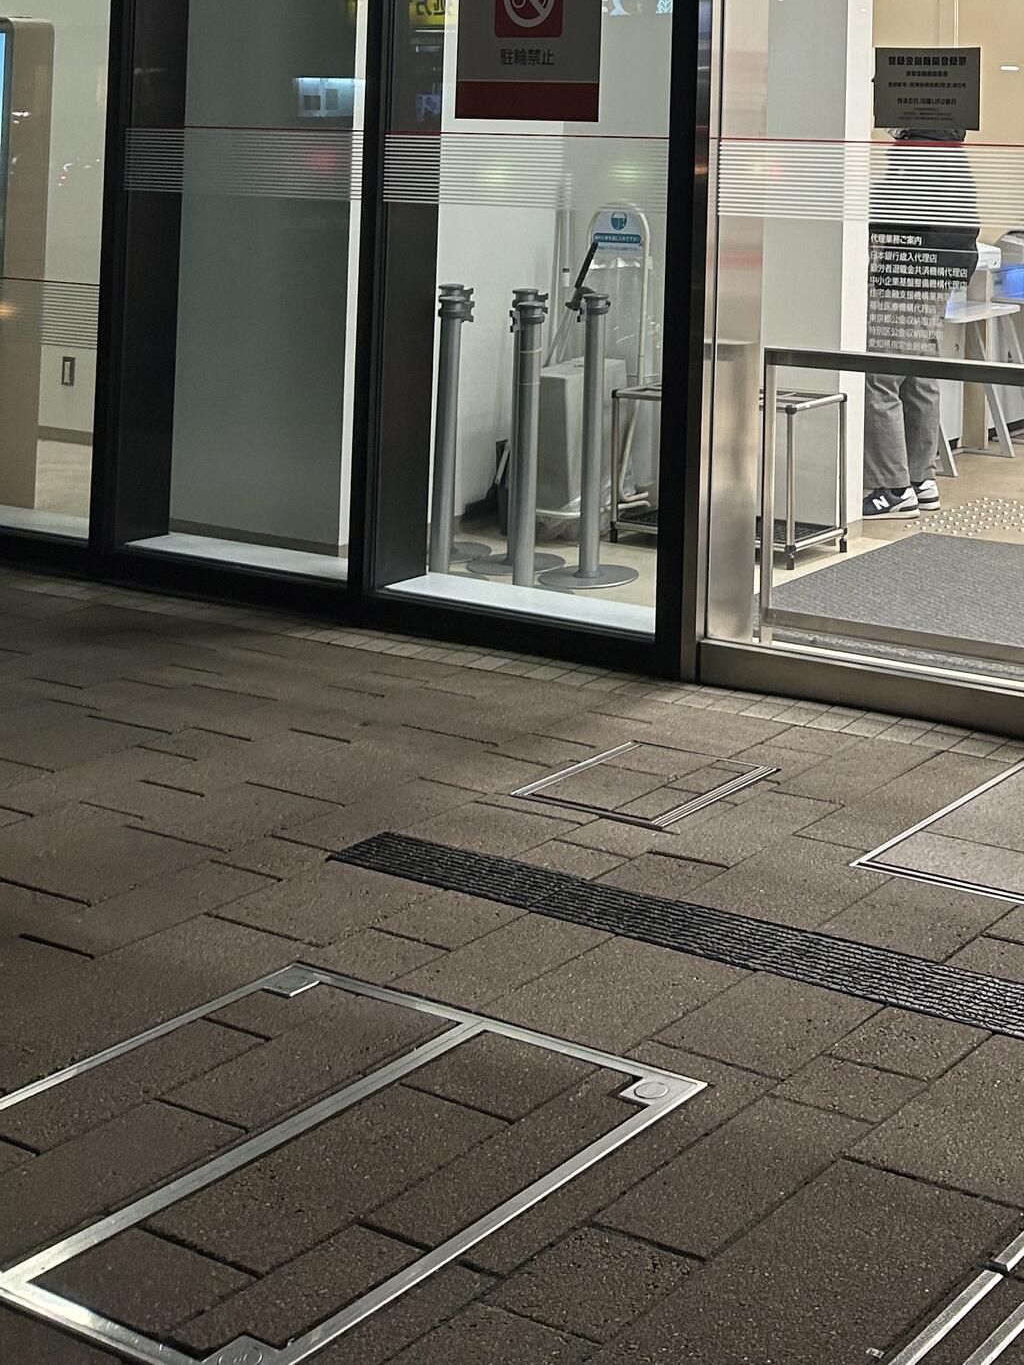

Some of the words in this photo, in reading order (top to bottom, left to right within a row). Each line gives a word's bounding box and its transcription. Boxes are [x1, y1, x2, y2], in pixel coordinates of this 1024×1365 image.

[500, 48, 554, 67] 駐輪禁止
[871, 233, 922, 245] 代理業務ご案内
